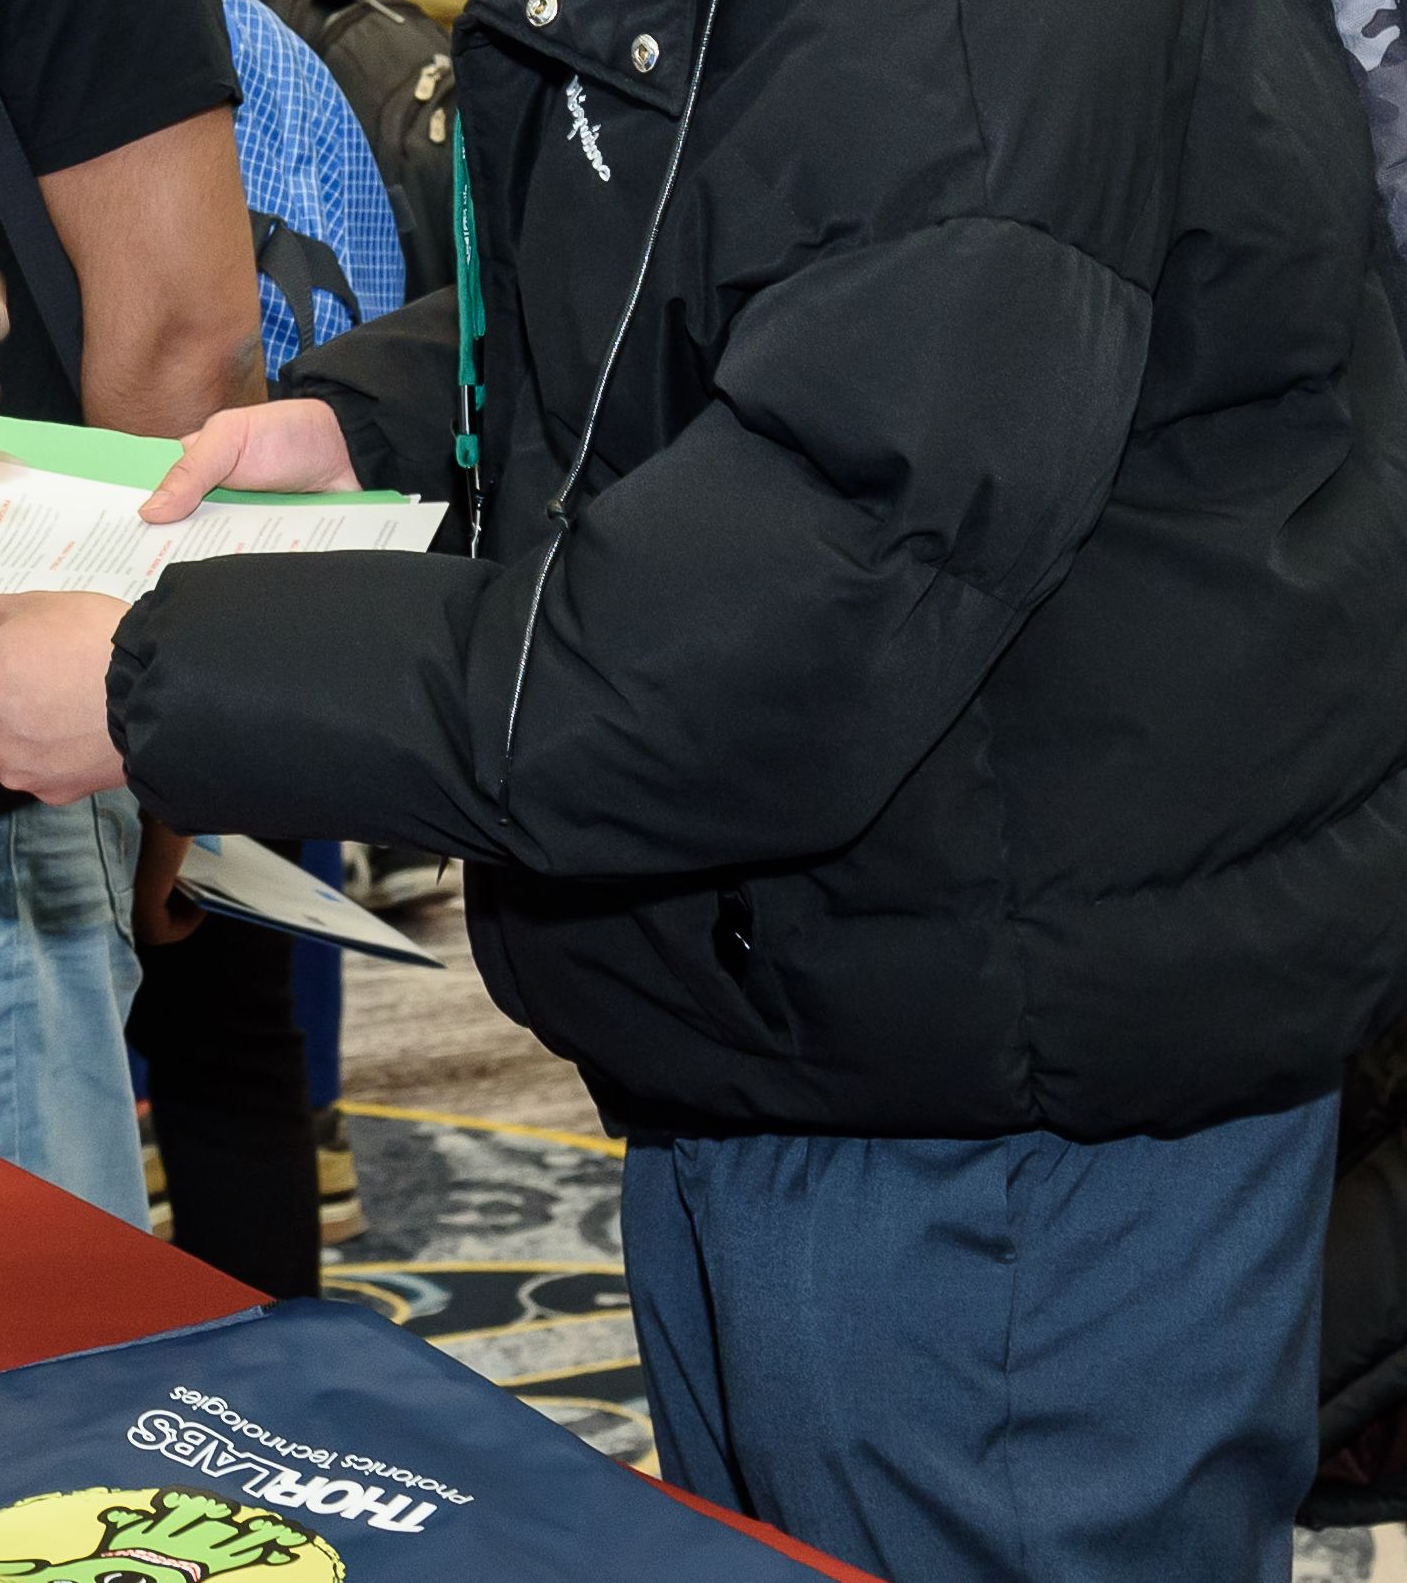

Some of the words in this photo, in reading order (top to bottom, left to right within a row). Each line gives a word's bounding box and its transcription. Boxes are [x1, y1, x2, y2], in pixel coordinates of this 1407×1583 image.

[170, 1386, 338, 1469] Technologies
[127, 1409, 437, 1532] THORLABS
[341, 1454, 475, 1505] Photonics
